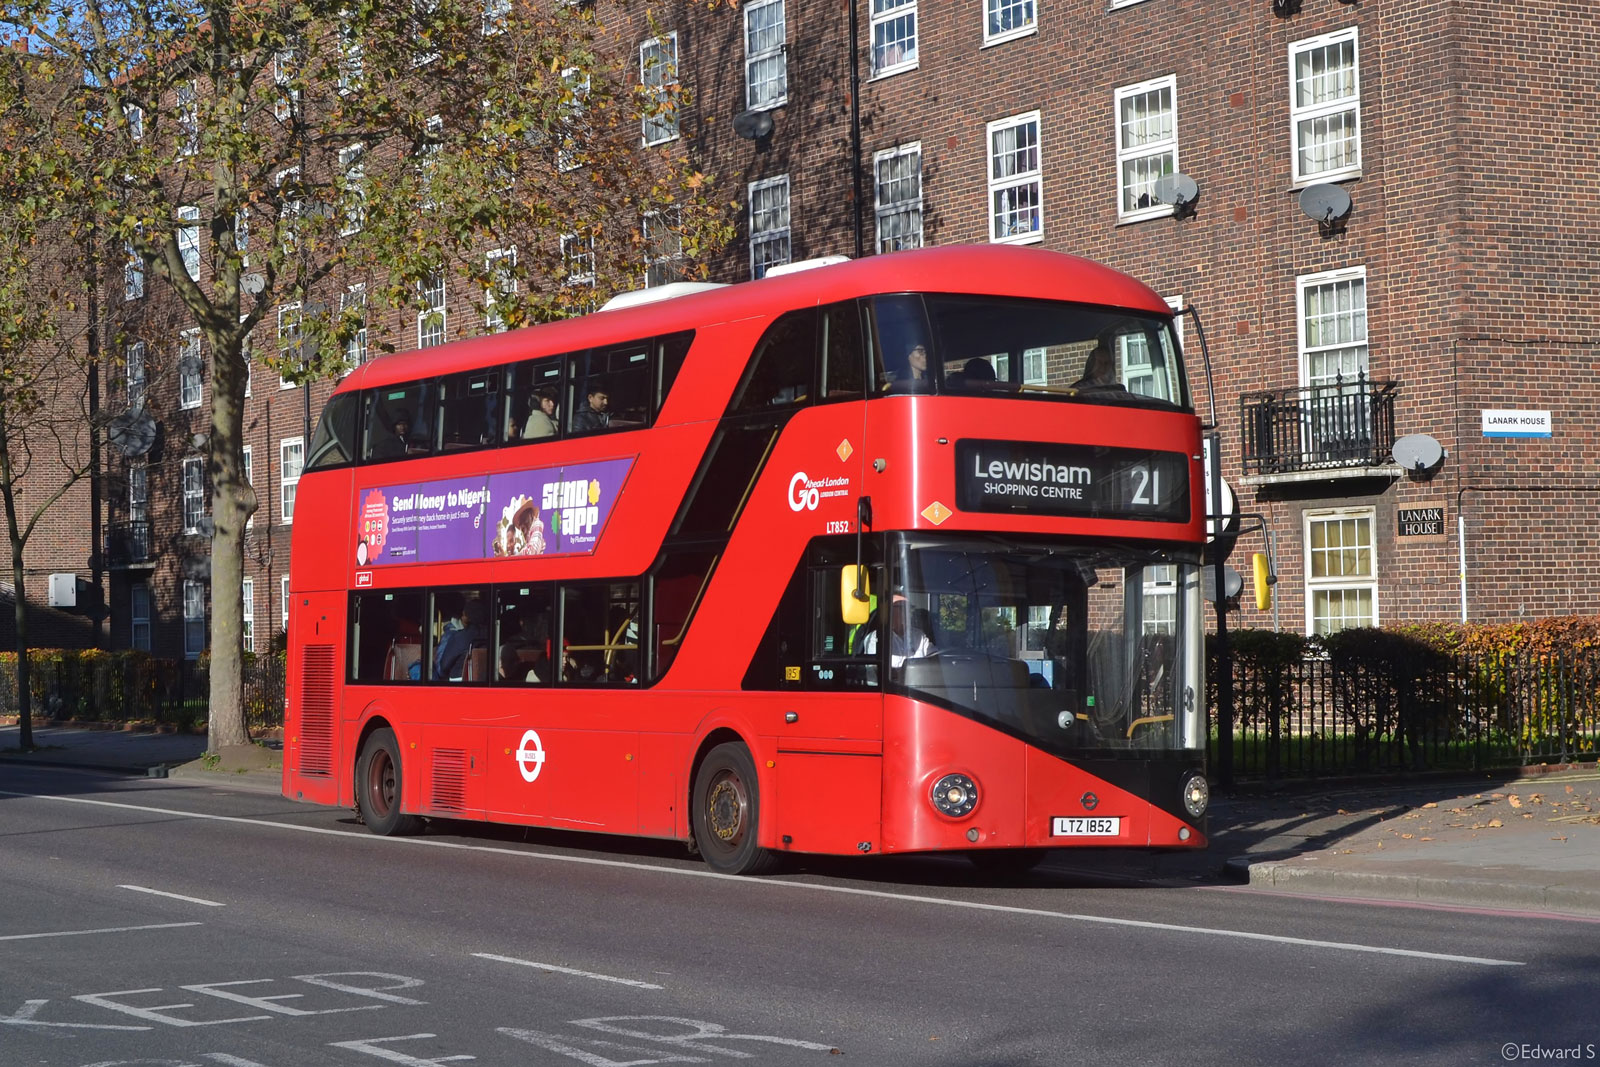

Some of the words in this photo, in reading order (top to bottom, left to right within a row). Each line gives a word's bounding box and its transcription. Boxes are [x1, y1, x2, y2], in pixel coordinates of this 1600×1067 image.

[1488, 417, 1518, 425] LANARK
[1520, 417, 1546, 425] HOUSE
[975, 454, 1091, 485] Lewisham
[984, 482, 1038, 497] SHOPPING
[1041, 486, 1083, 500] CENTRE
[1131, 466, 1160, 505] 21
[392, 494, 414, 512] Send
[414, 493, 446, 511] Money
[447, 491, 457, 507] to
[1401, 509, 1440, 521] LANARK
[826, 520, 849, 534] LT852
[1405, 522, 1438, 535] HOUSE
[1060, 819, 1084, 833] LTZ
[1086, 819, 1112, 833] 1852
